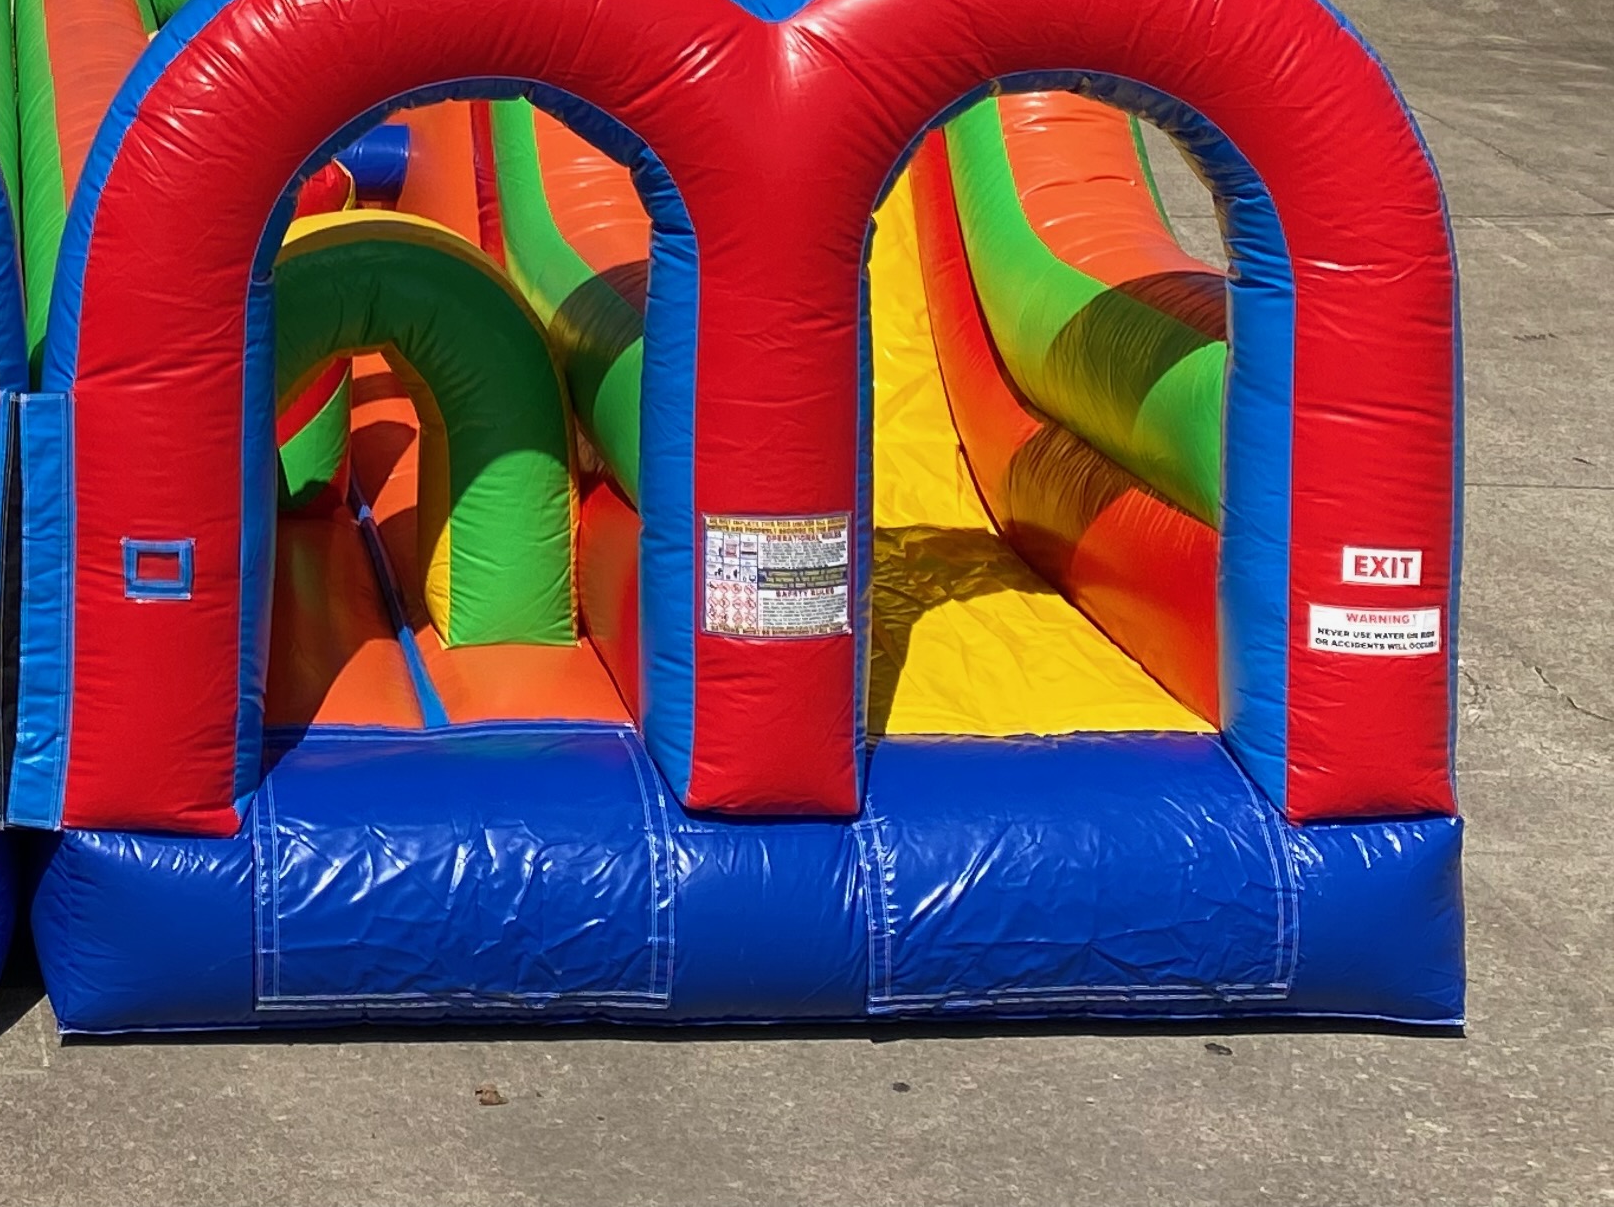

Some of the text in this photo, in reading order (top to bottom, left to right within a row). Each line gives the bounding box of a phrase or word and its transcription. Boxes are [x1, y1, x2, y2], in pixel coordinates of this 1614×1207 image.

[1354, 555, 1413, 579] EXIT
[1346, 612, 1410, 624] WARNING
[1317, 627, 1349, 637] NEVER
[1353, 631, 1372, 639] USE
[1315, 637, 1328, 646] OR
[1331, 639, 1385, 650] ACCIDENTS
[1387, 642, 1407, 650] WILL
